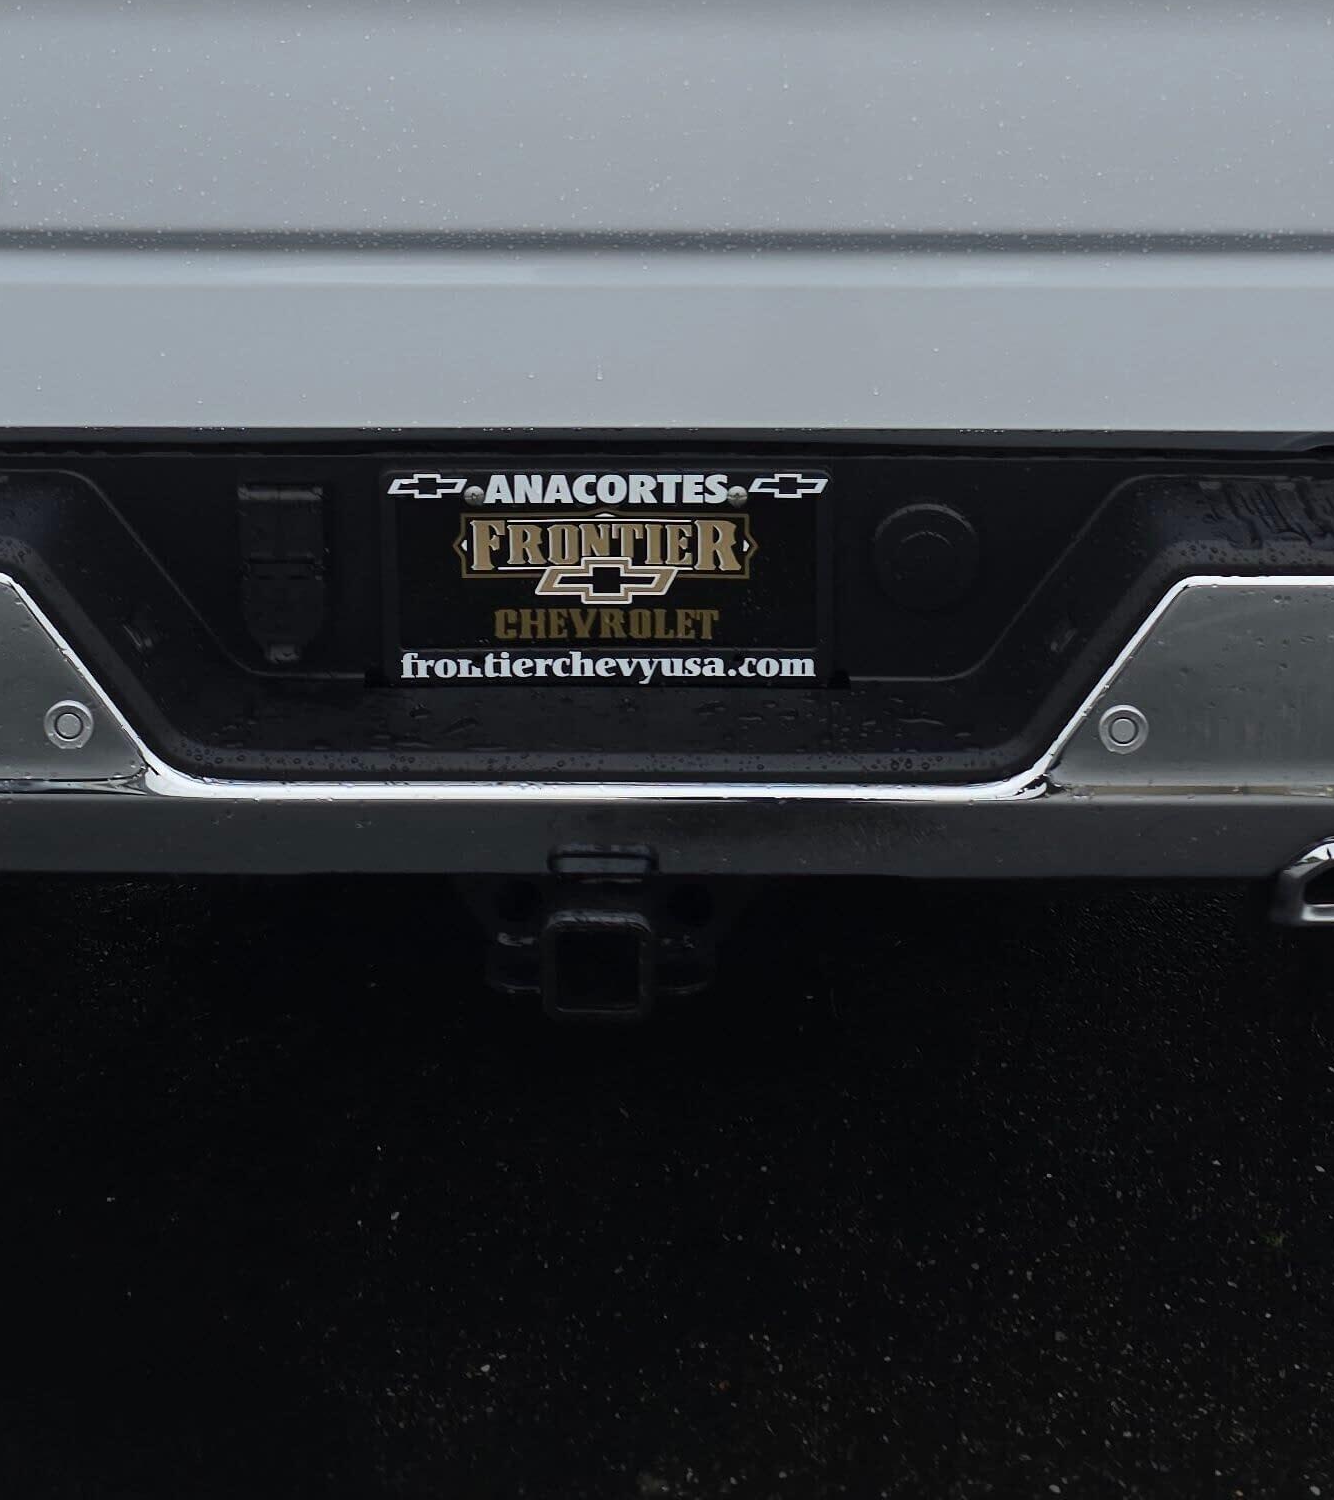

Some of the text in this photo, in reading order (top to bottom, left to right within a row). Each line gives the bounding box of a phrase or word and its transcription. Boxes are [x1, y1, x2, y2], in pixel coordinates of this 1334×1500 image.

[482, 474, 729, 504] ANACORTES
[469, 519, 743, 571] FRONTIER
[494, 607, 721, 640] CHEVROLET
